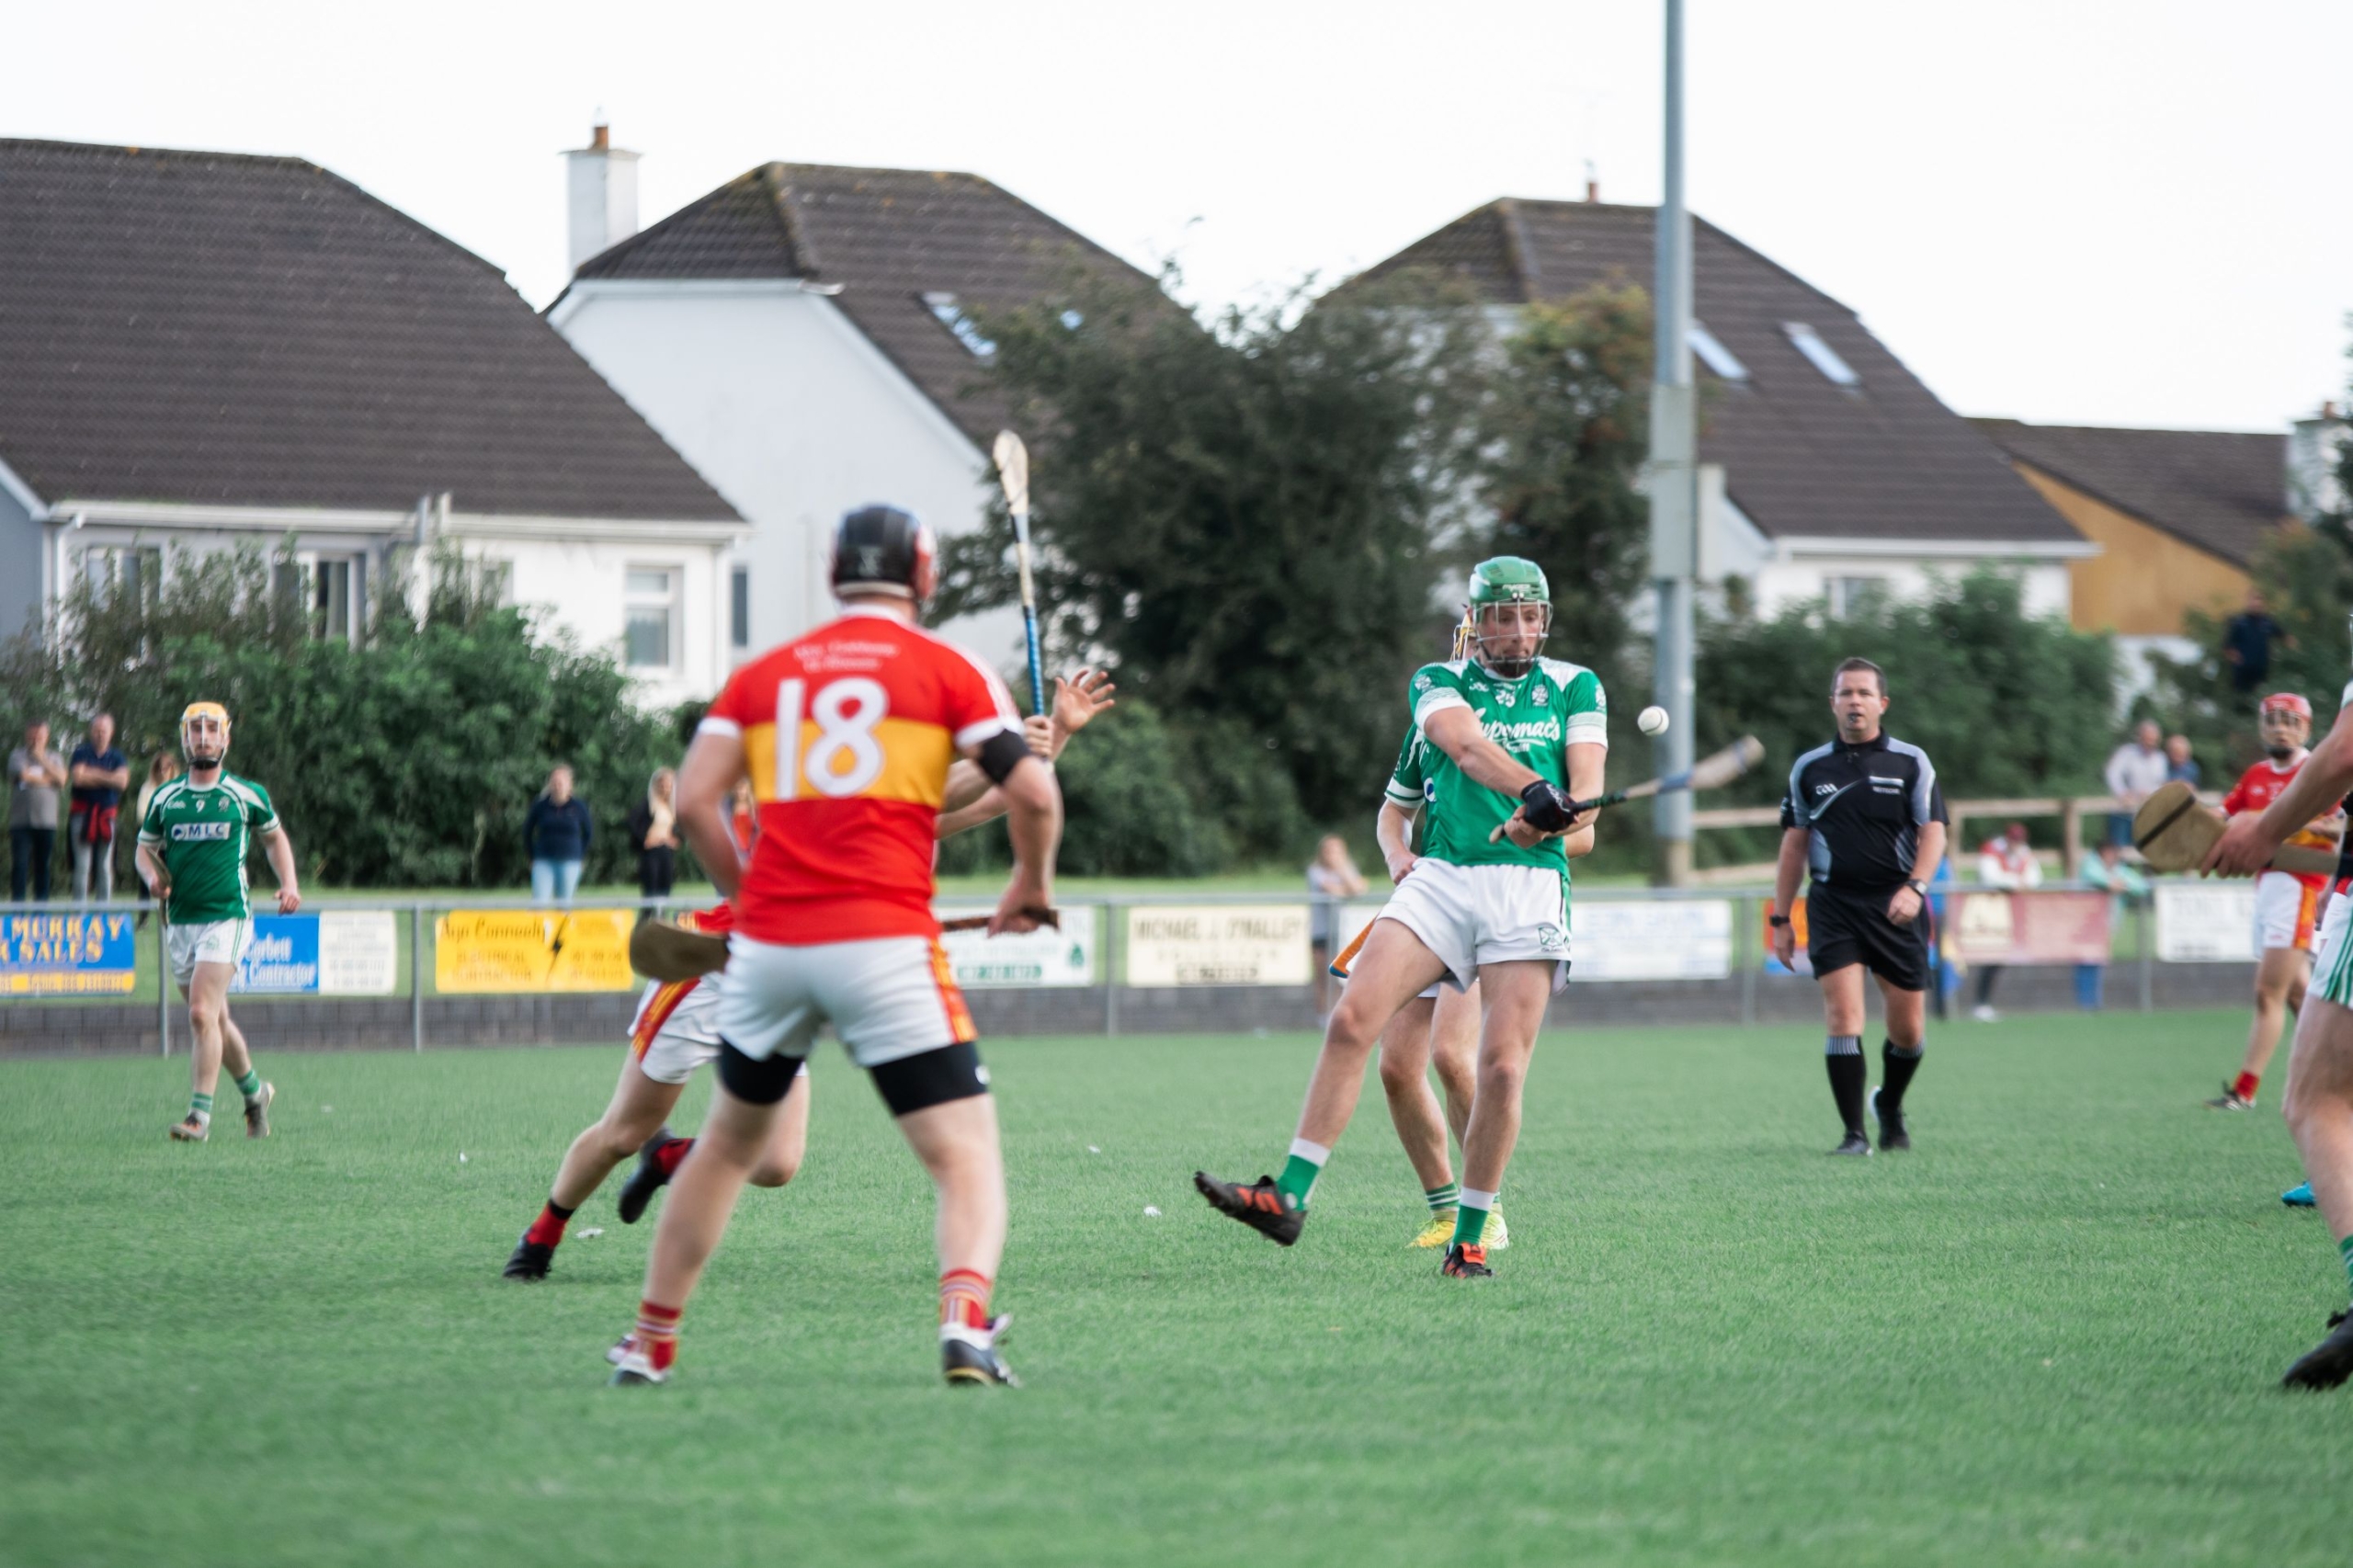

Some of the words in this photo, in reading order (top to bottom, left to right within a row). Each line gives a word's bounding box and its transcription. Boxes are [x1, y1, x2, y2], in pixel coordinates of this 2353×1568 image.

[1495, 688, 1516, 709] 25
[775, 676, 890, 801] 18
[195, 800, 206, 813] 9
[11, 915, 125, 942] MURRAY
[1134, 916, 1201, 940] MICHAEL
[18, 938, 104, 964] SALES
[249, 959, 317, 987] Contractor
